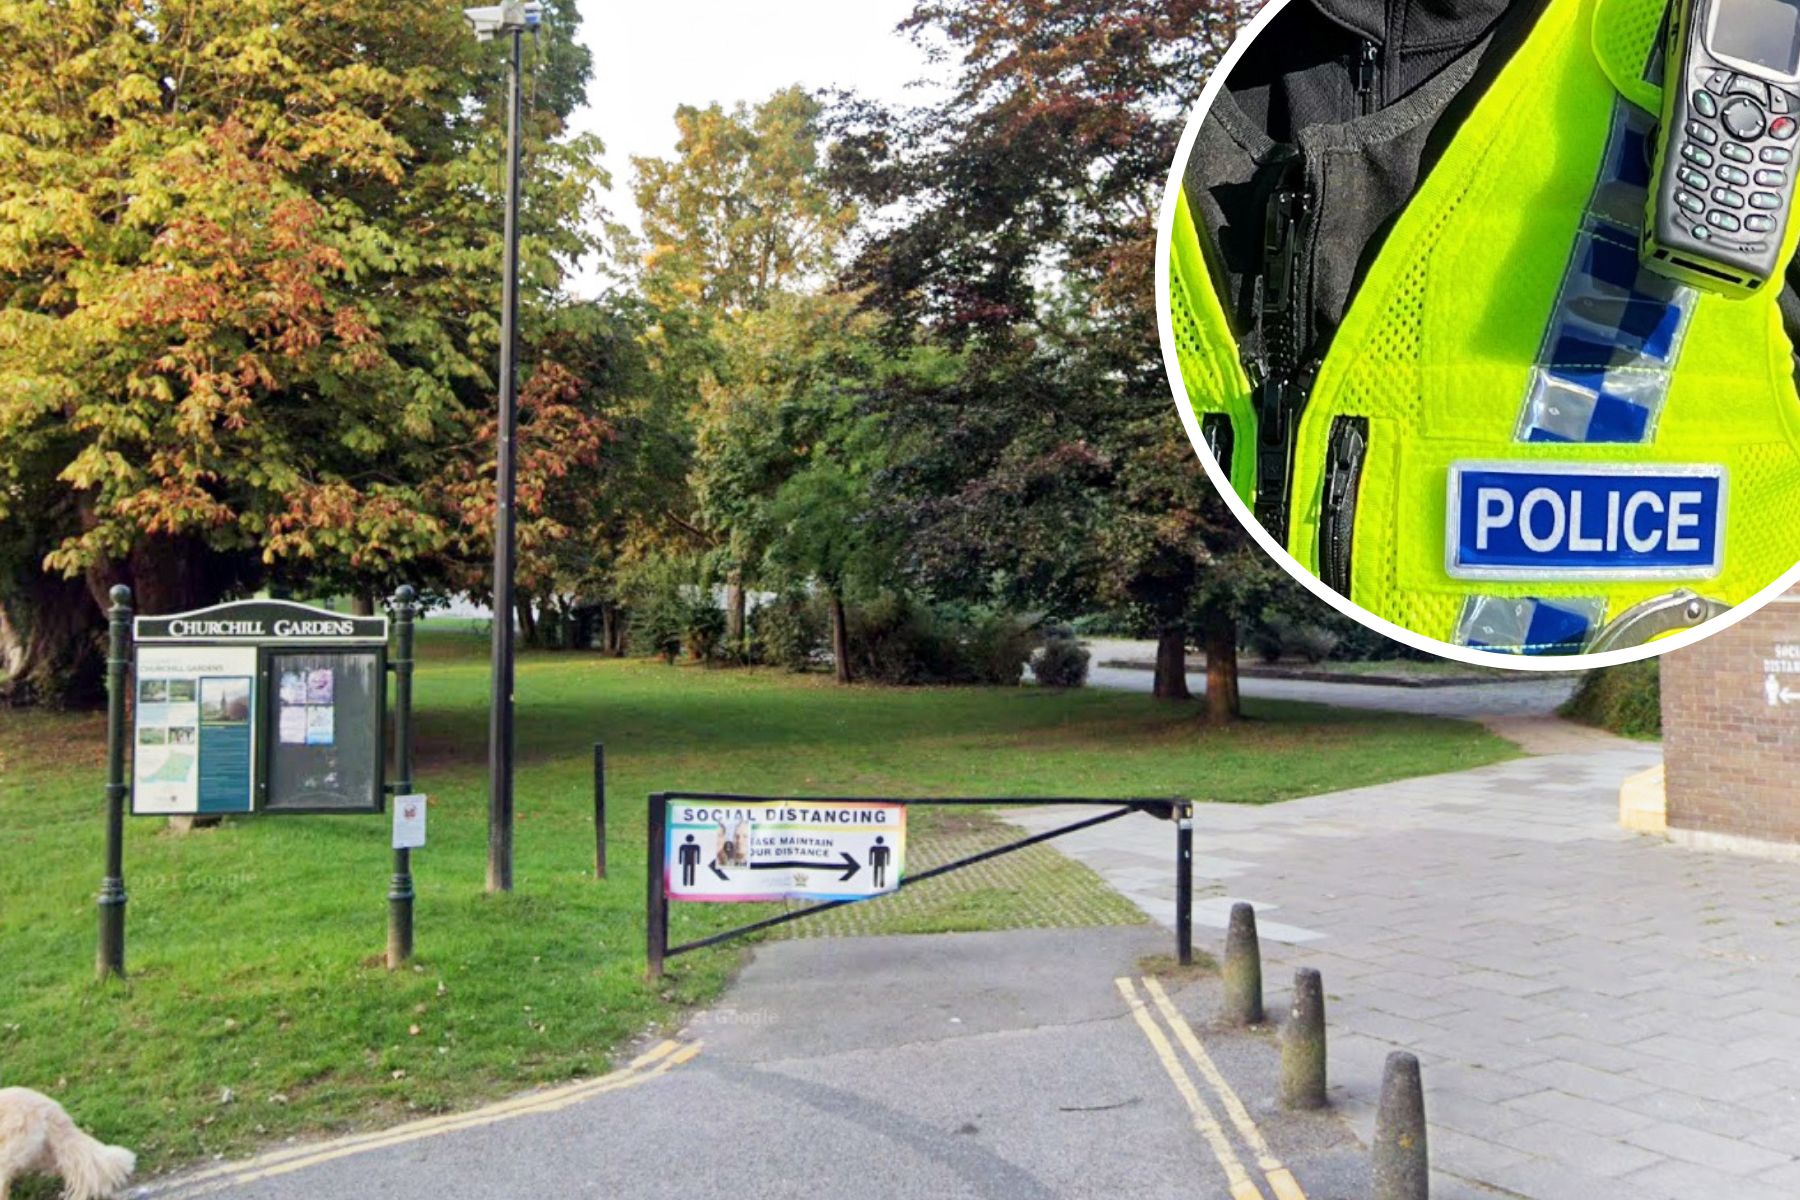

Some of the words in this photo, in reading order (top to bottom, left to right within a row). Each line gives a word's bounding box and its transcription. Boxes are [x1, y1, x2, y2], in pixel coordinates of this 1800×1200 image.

[1476, 487, 1702, 553] POLICE
[168, 619, 265, 636] CHURCHILL
[273, 619, 354, 636] GARDENS
[684, 808, 756, 822] SOCIAL
[766, 809, 886, 824] DISTANCING
[780, 836, 834, 848] MAINTAIN
[774, 847, 830, 858] DISTANCE
